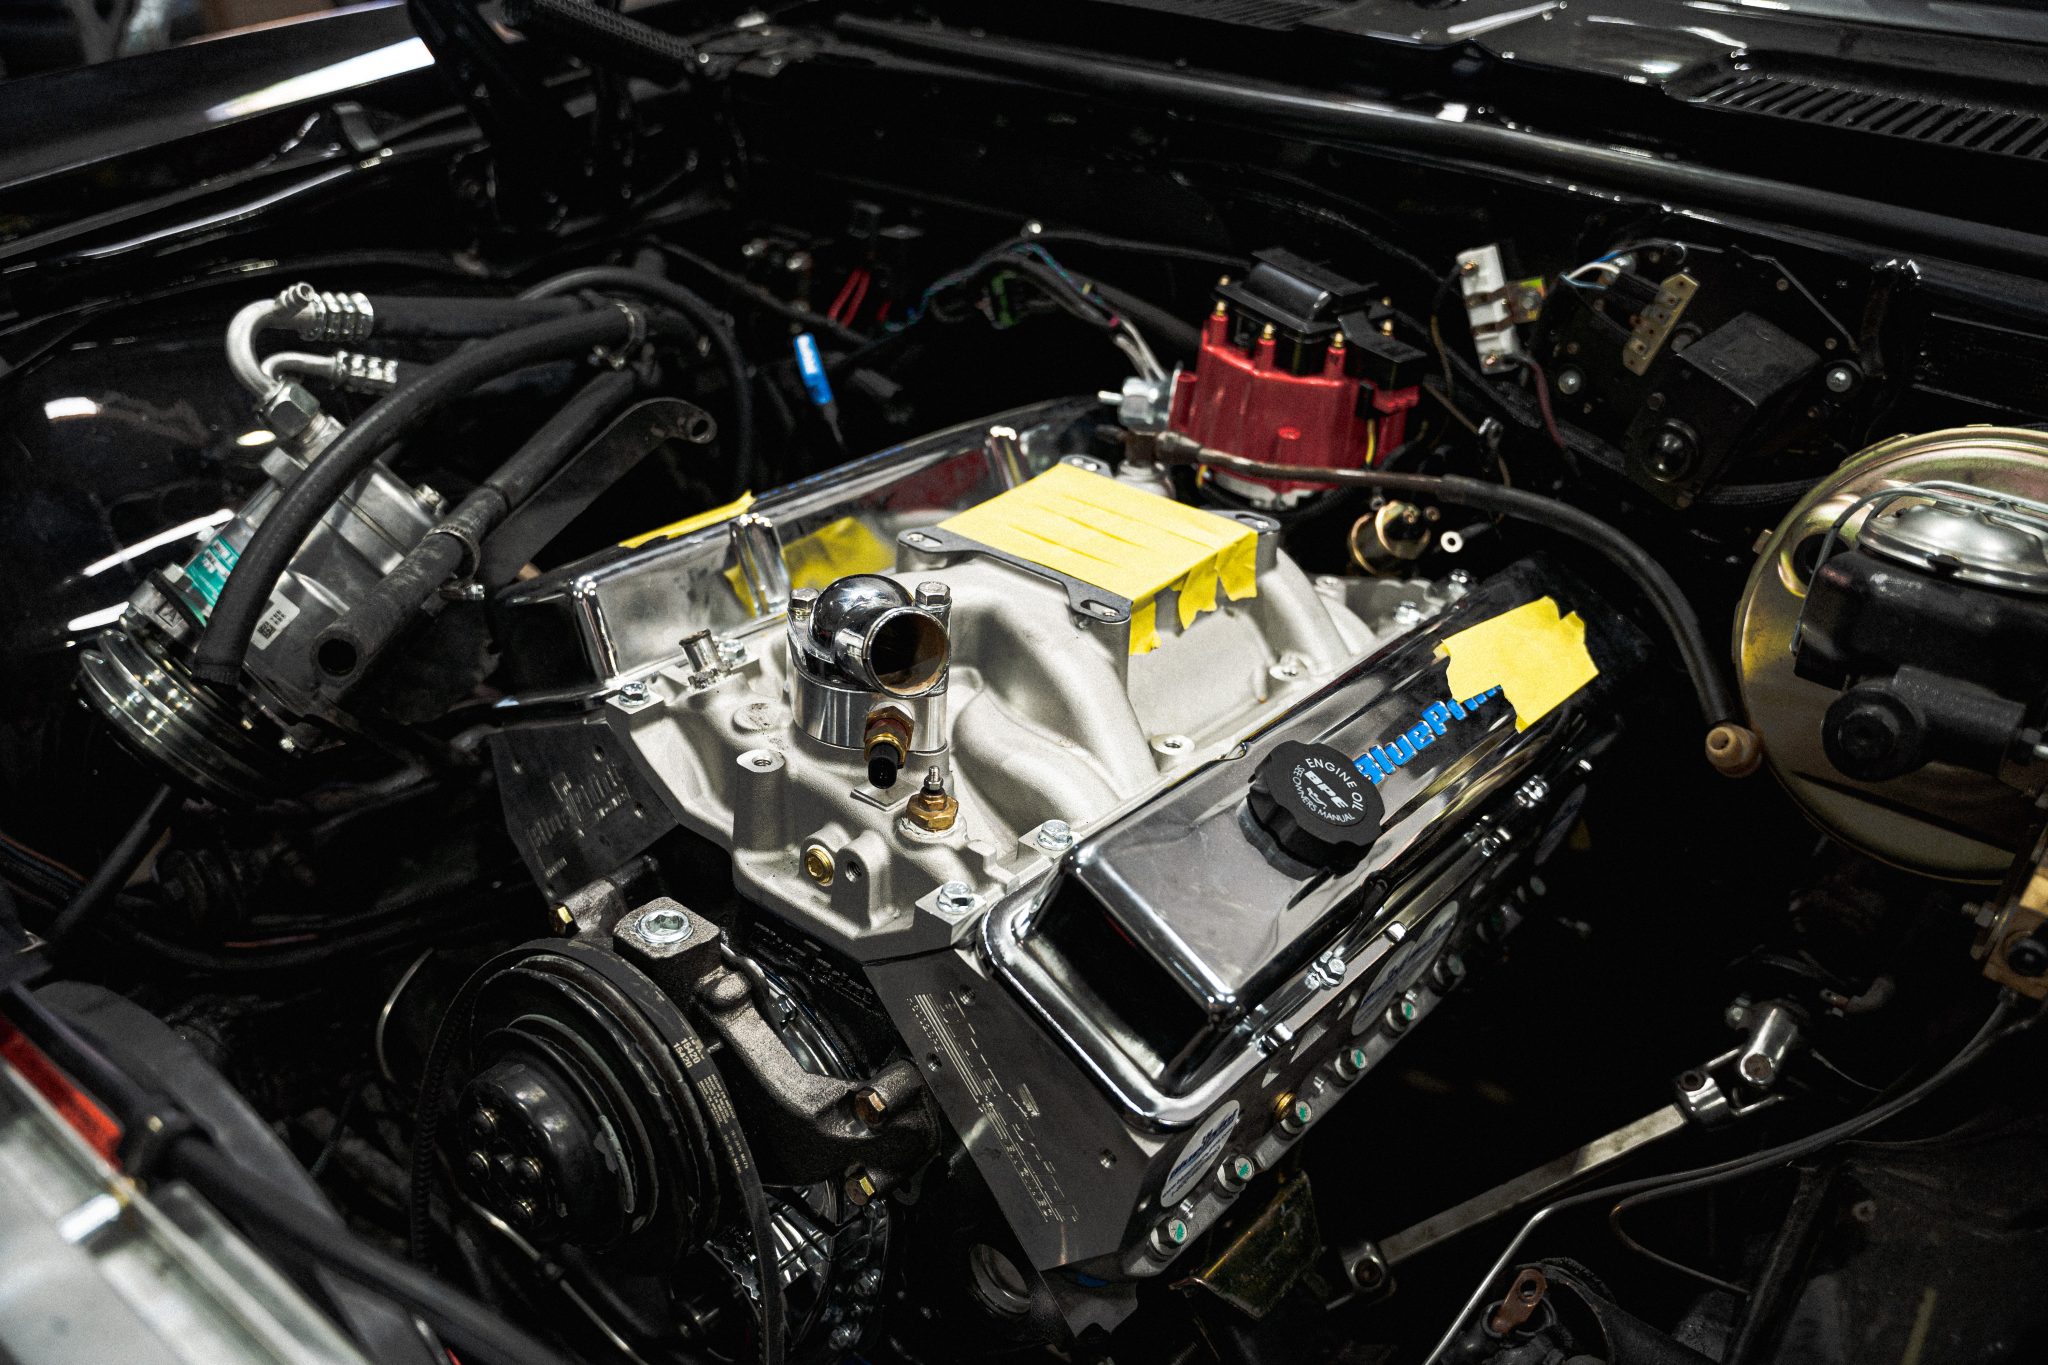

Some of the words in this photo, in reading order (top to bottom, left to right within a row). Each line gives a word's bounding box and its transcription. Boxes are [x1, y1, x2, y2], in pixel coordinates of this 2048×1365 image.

[1292, 777, 1317, 812] OWNERS
[1317, 808, 1356, 823] MANUAL
[1304, 770, 1349, 809] BPE
[1305, 757, 1358, 789] ENGINE
[1352, 792, 1364, 812] OIL
[673, 1042, 693, 1069] 15420
[681, 1038, 701, 1064] 15420
